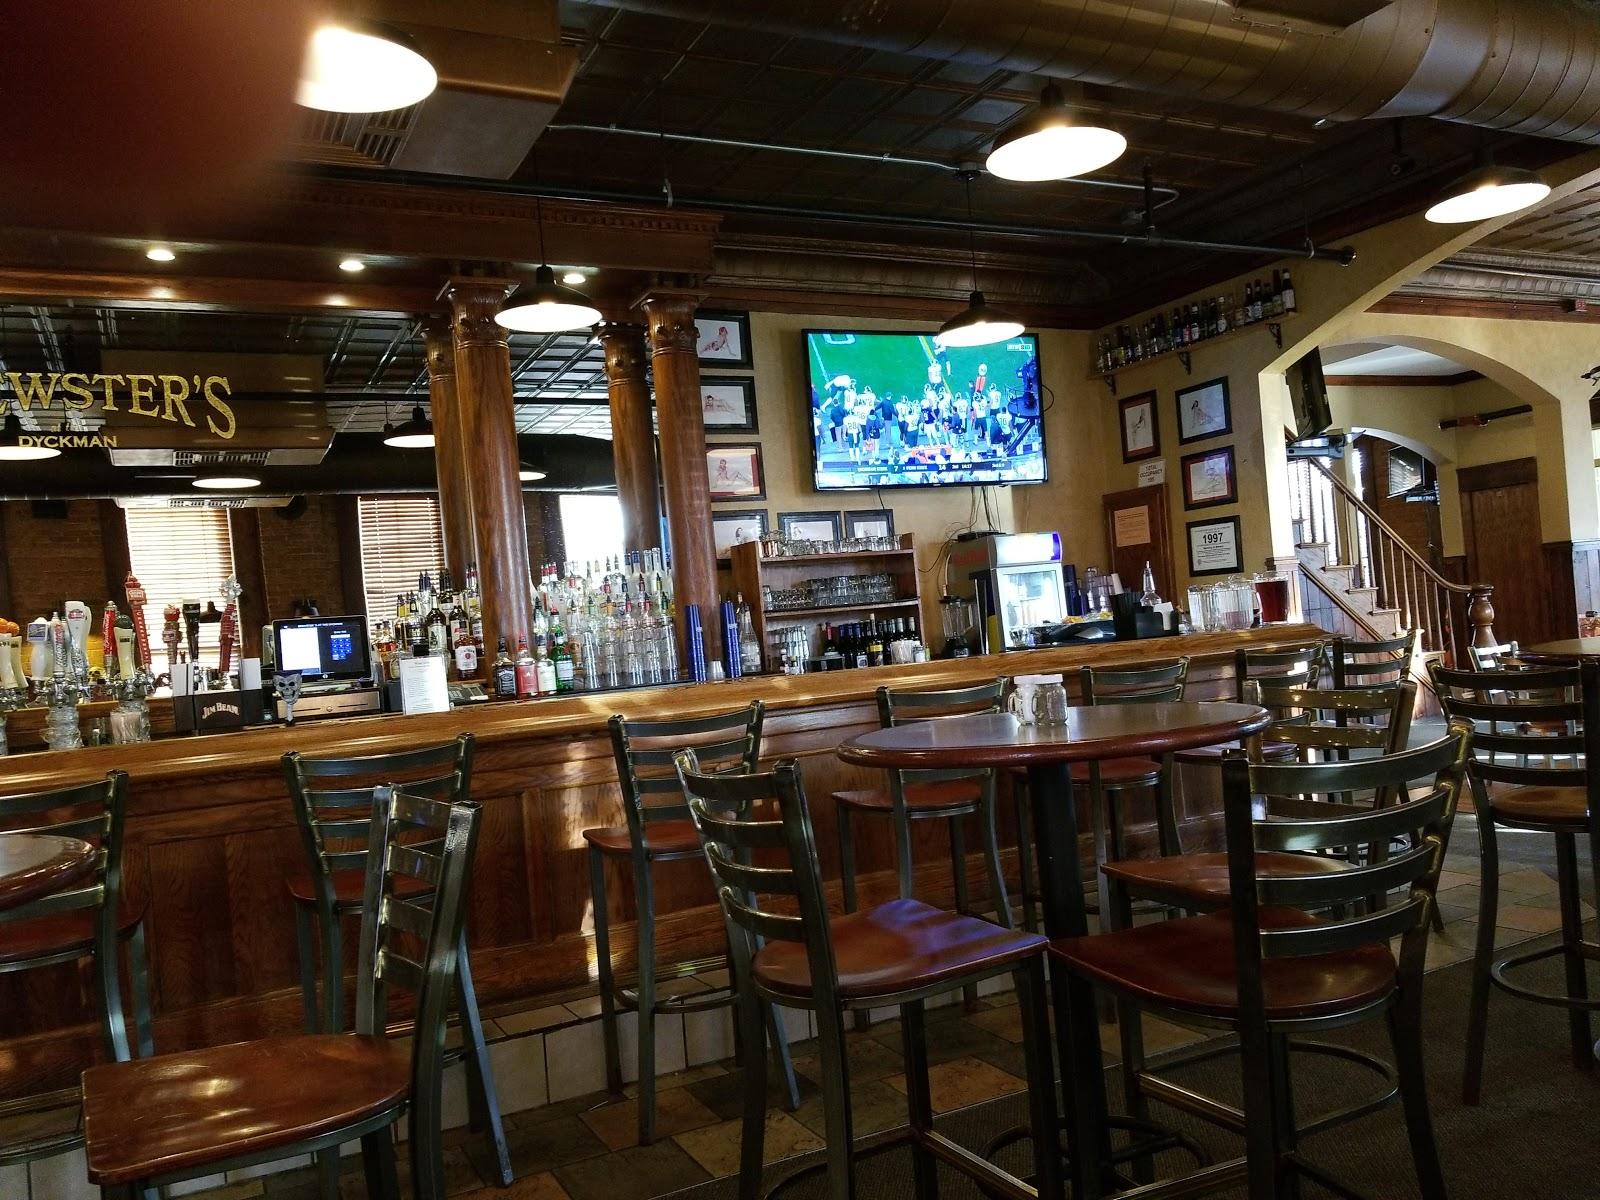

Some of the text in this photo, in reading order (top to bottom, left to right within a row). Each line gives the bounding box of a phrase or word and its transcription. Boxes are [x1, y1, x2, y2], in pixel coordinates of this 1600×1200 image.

[0, 372, 236, 440] WSTER'S
[18, 435, 118, 448] DYCKMAN
[1202, 532, 1224, 544] 1997
[201, 702, 240, 720] JIM BEAM
